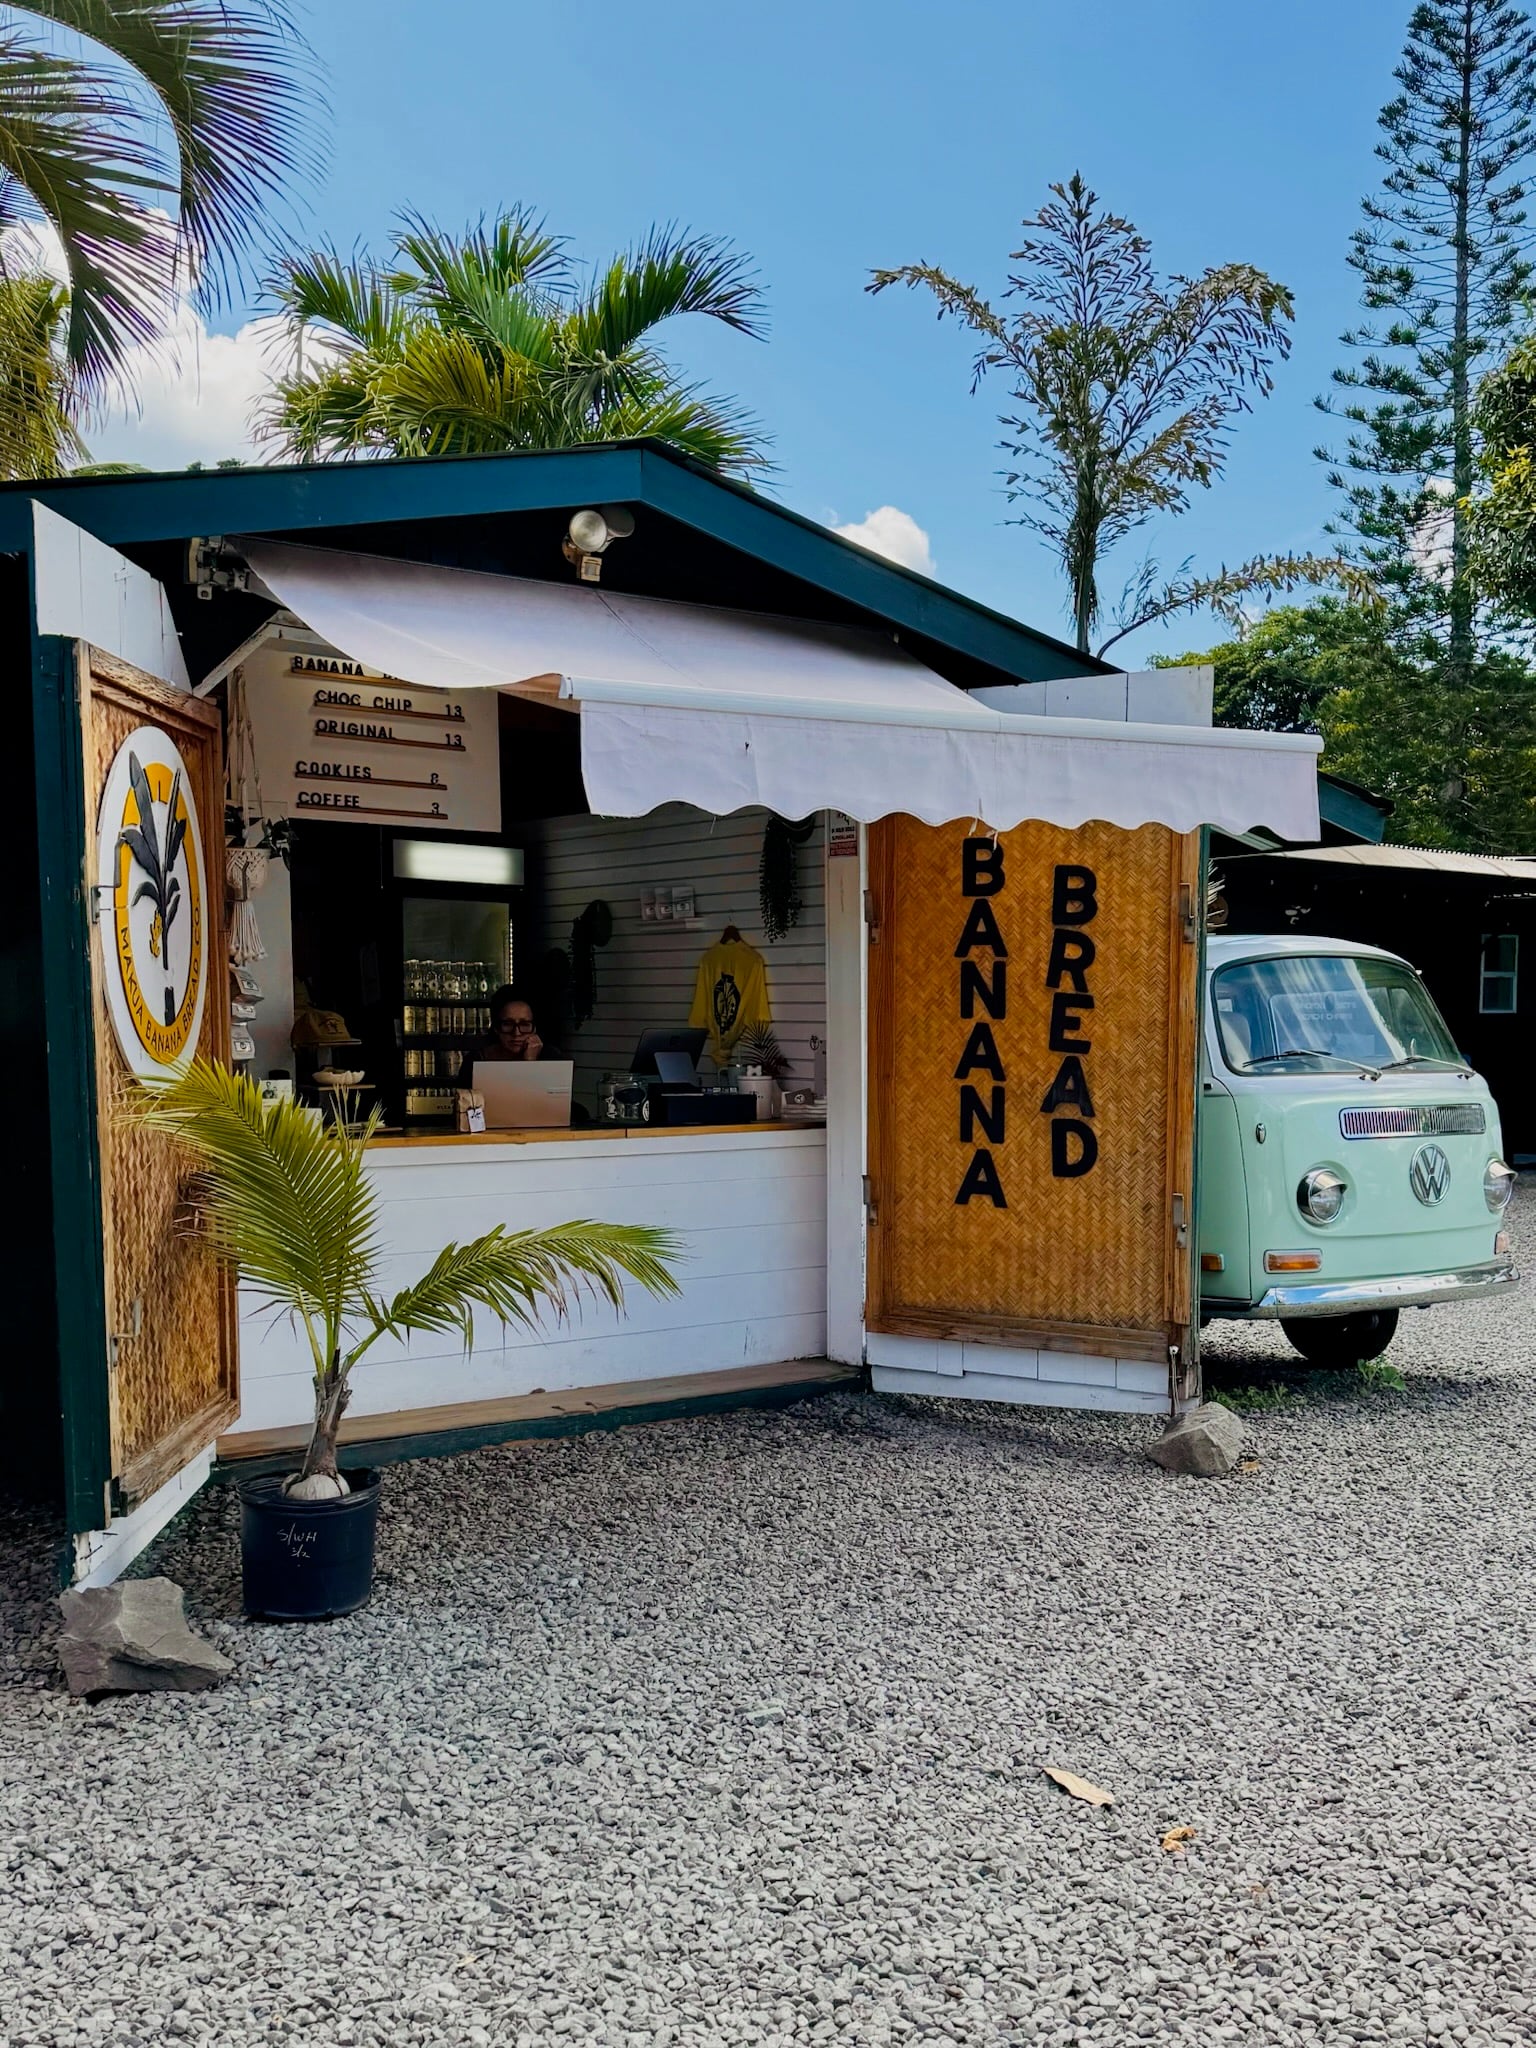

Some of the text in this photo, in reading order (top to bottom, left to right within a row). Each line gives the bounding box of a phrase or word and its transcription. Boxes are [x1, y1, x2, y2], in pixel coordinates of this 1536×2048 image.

[294, 656, 364, 676] BANANA
[315, 690, 462, 718] CHOC CHIP 13
[316, 719, 462, 746] ORIGINAL 13
[296, 760, 371, 779] COOKIES
[297, 791, 440, 815] COFFEE 3
[121, 927, 143, 1026] MAKUA
[146, 1020, 183, 1053] BANANA
[954, 838, 1008, 1208] BANANA
[1040, 865, 1098, 1177] BREAD
[1413, 1146, 1447, 1202] VW
